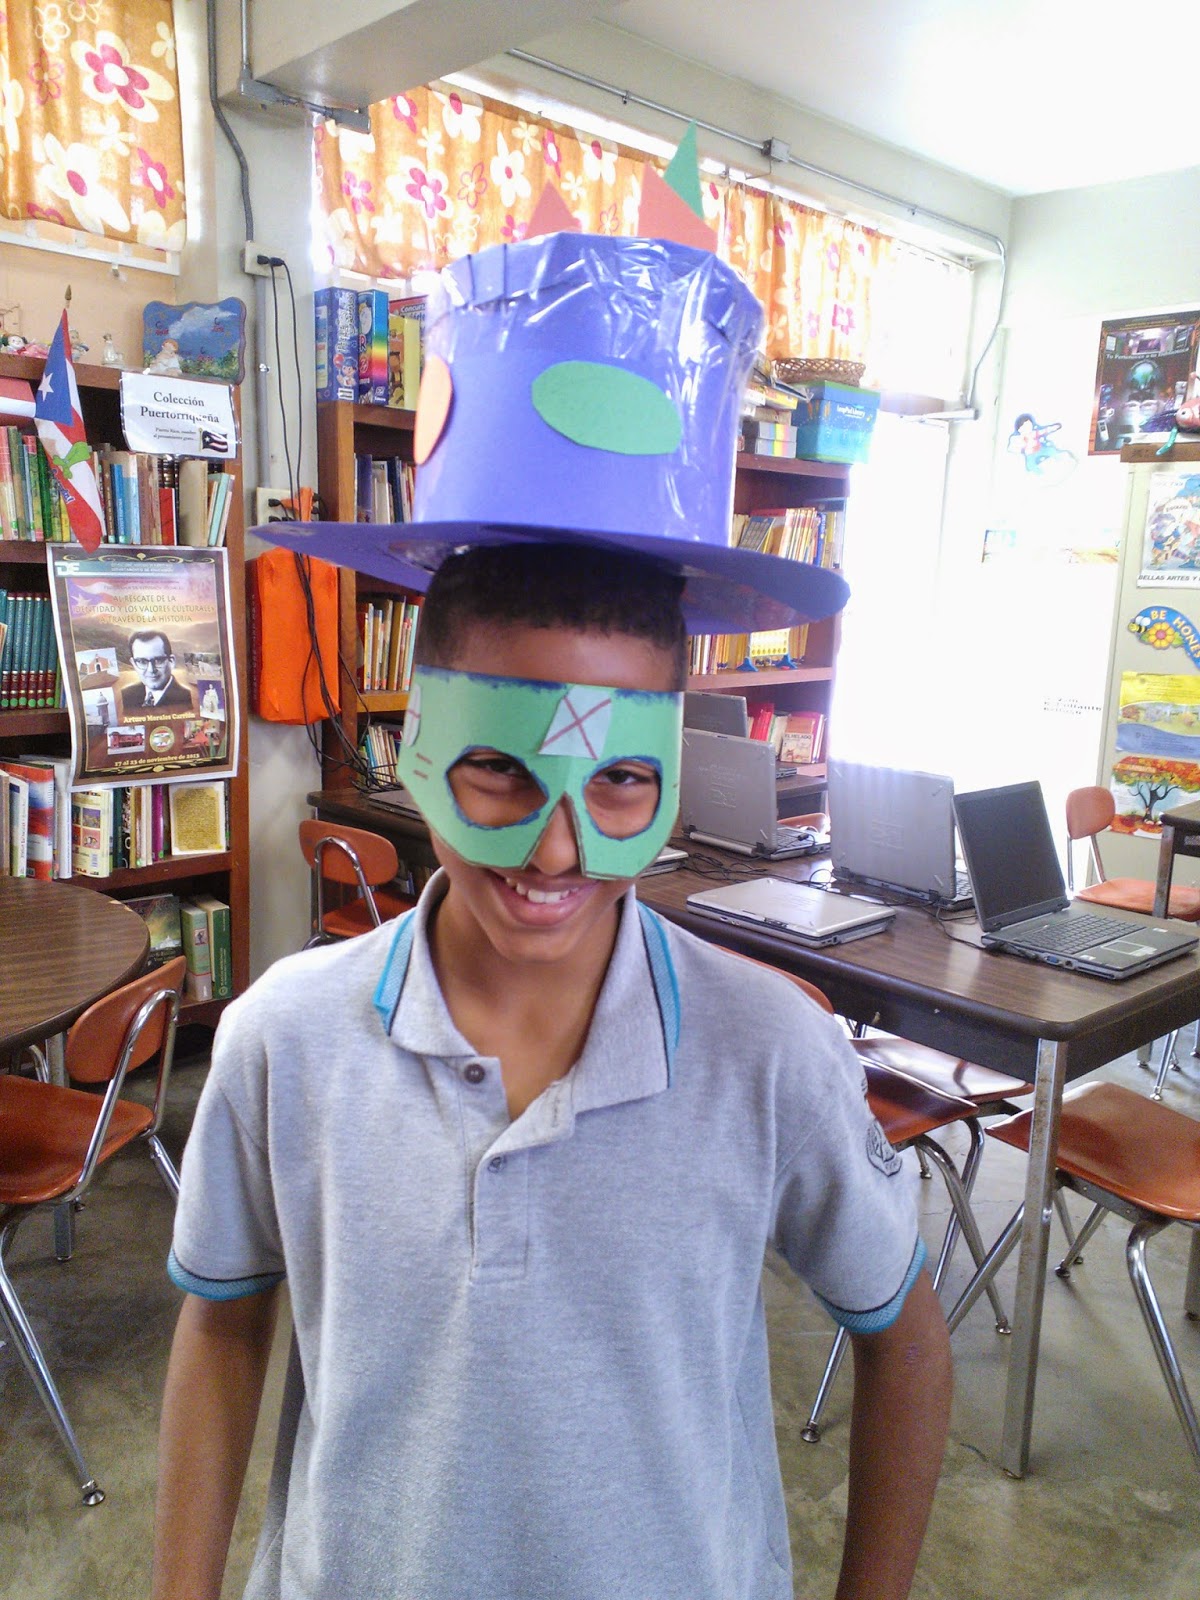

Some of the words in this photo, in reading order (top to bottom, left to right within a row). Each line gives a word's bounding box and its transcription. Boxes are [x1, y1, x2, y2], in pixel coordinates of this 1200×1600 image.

[153, 391, 205, 407] Colección
[125, 594, 154, 603] RESCATE
[73, 605, 116, 613] IDENTIDAD
[124, 605, 138, 613] LOS
[138, 605, 170, 613] VALORES
[171, 605, 215, 613] CULTURALES
[136, 615, 146, 623] DE
[147, 615, 157, 623] LA
[159, 615, 193, 623] HISTORIA
[1150, 610, 1167, 620] BE
[146, 714, 172, 722] Morales
